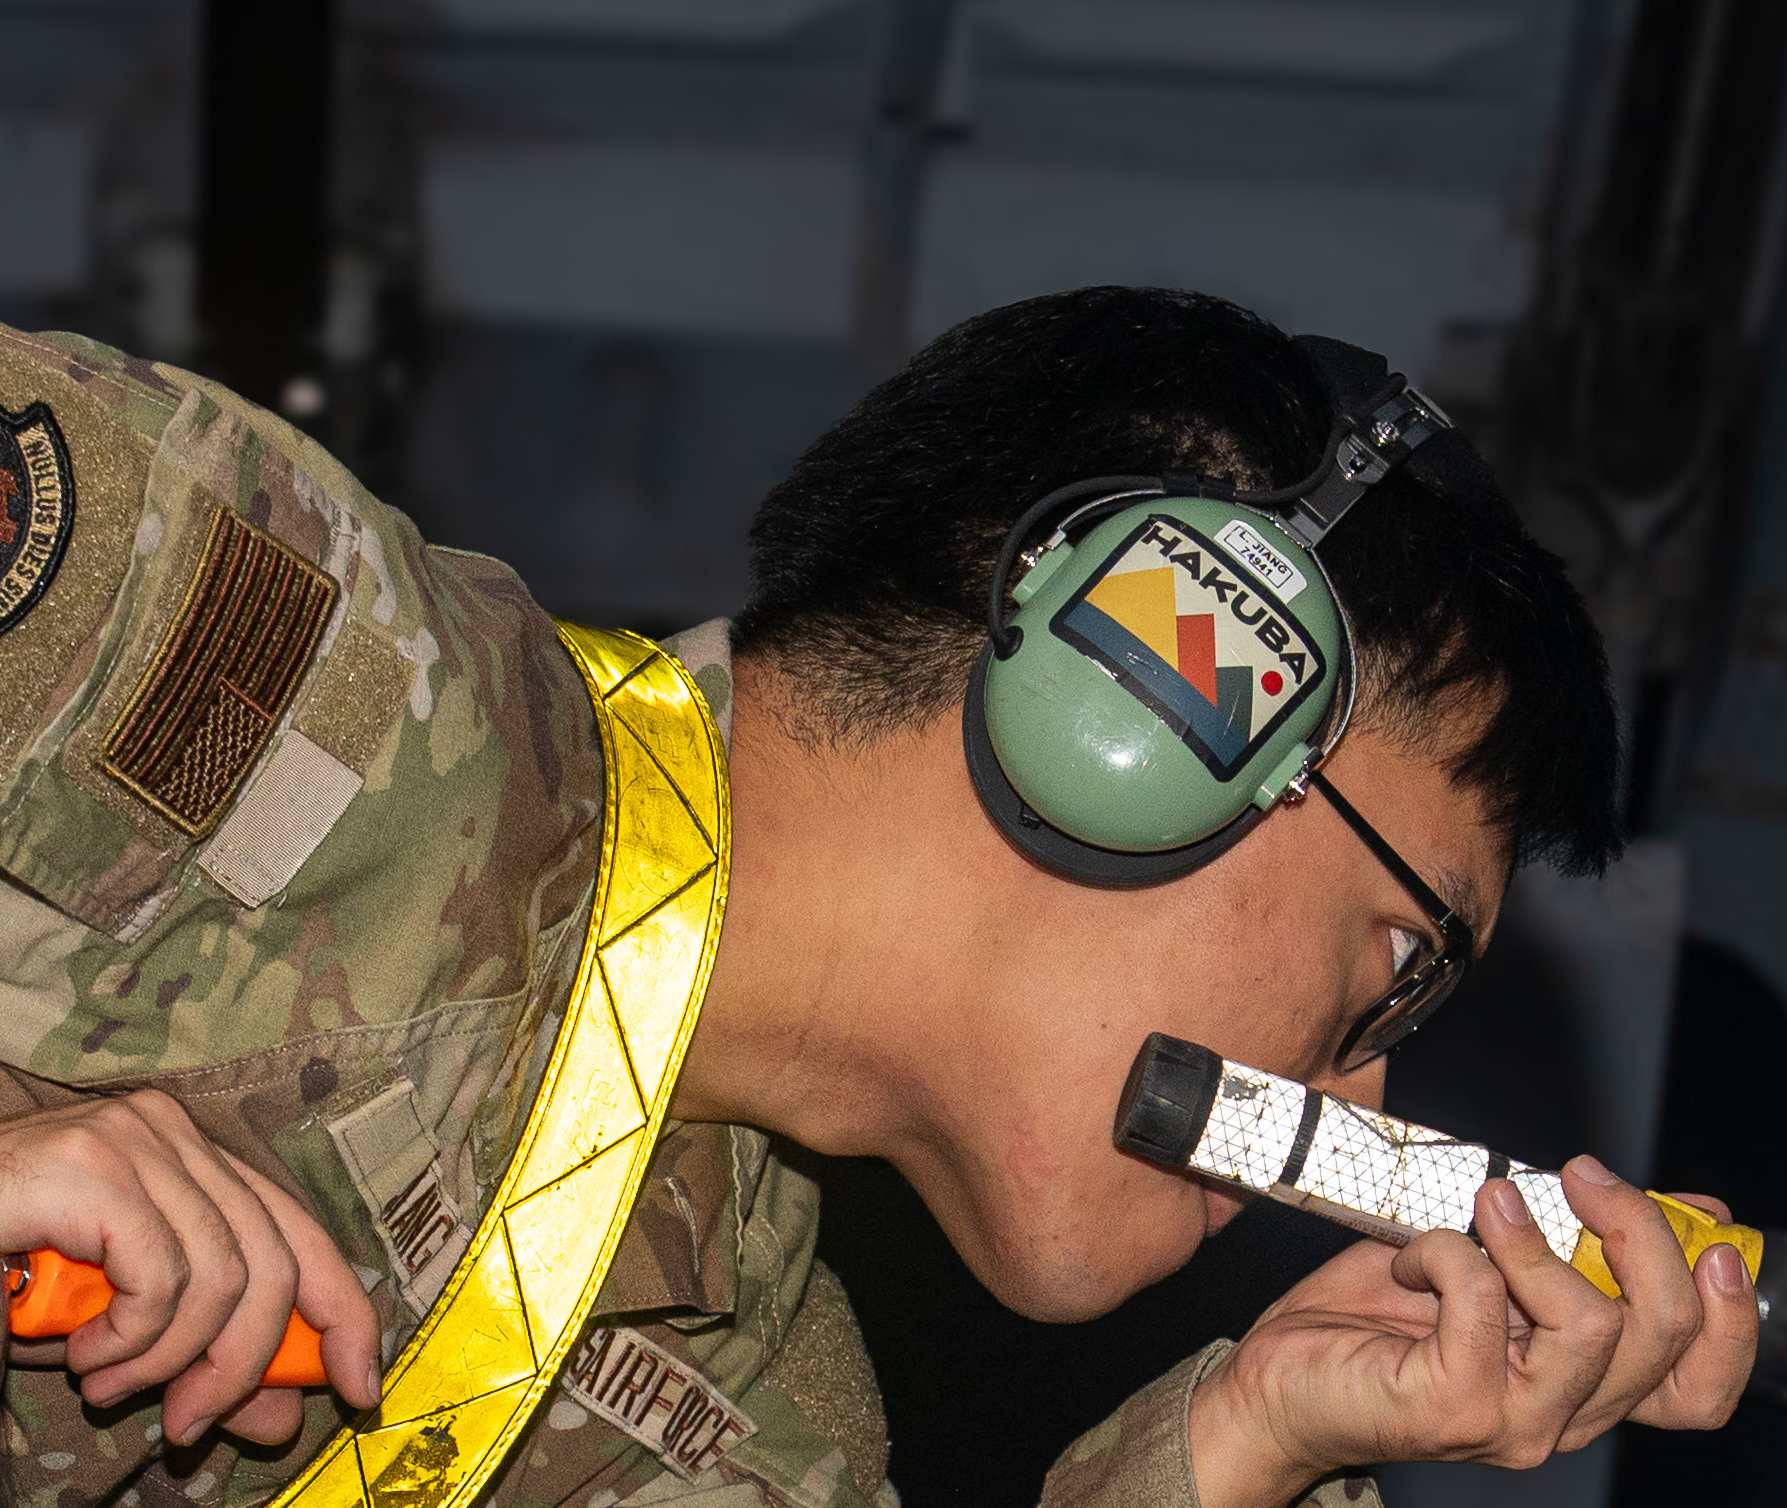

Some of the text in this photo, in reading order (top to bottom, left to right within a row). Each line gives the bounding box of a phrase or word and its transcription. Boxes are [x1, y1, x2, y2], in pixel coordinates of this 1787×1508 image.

[25, 440, 57, 525] NULLUS
[16, 531, 51, 580] DIES
[1239, 530, 1288, 575] L. JIANG
[1241, 546, 1273, 577] 74941
[1140, 524, 1307, 685] HAKUBA
